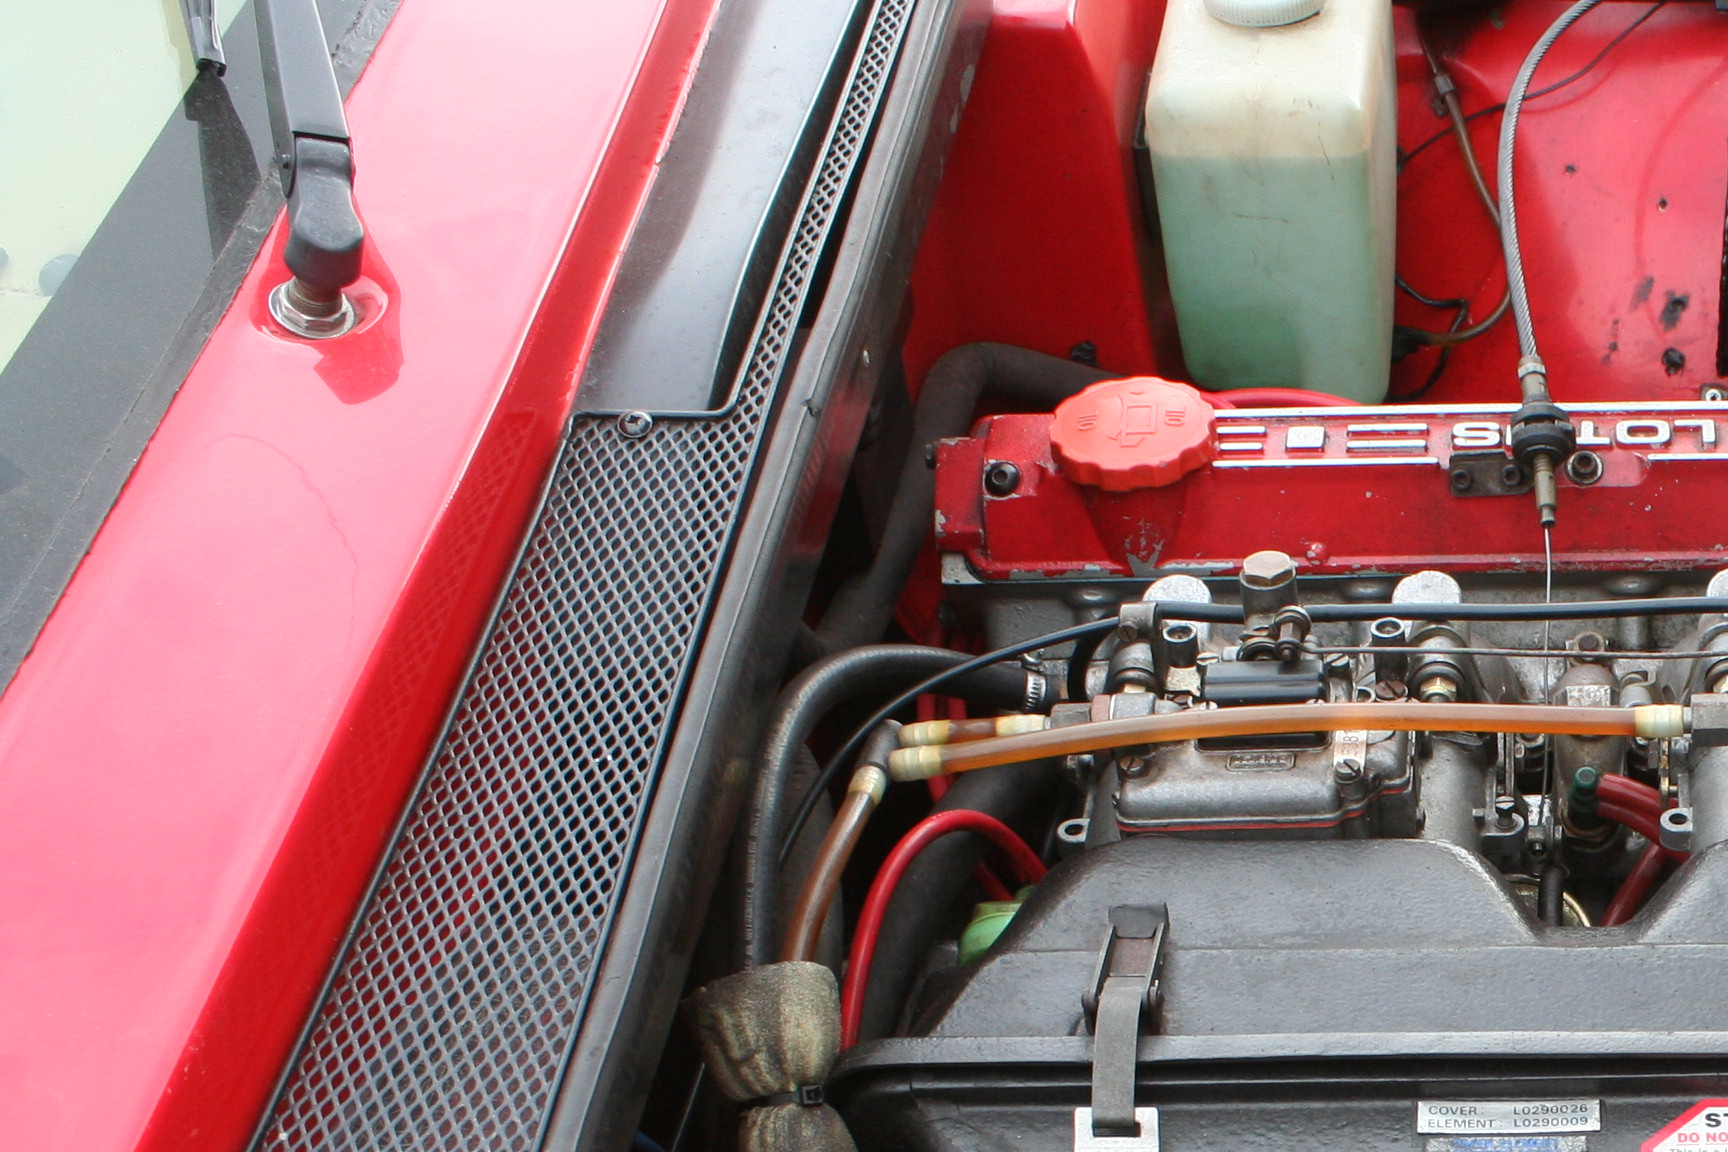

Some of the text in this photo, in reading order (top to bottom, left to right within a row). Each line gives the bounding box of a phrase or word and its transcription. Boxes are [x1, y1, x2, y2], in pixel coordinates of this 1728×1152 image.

[1452, 419, 1716, 447] LOTS
[1514, 1104, 1588, 1116] L0290026
[1514, 1117, 1588, 1128] L0290009
[1677, 1133, 1699, 1143] DO
